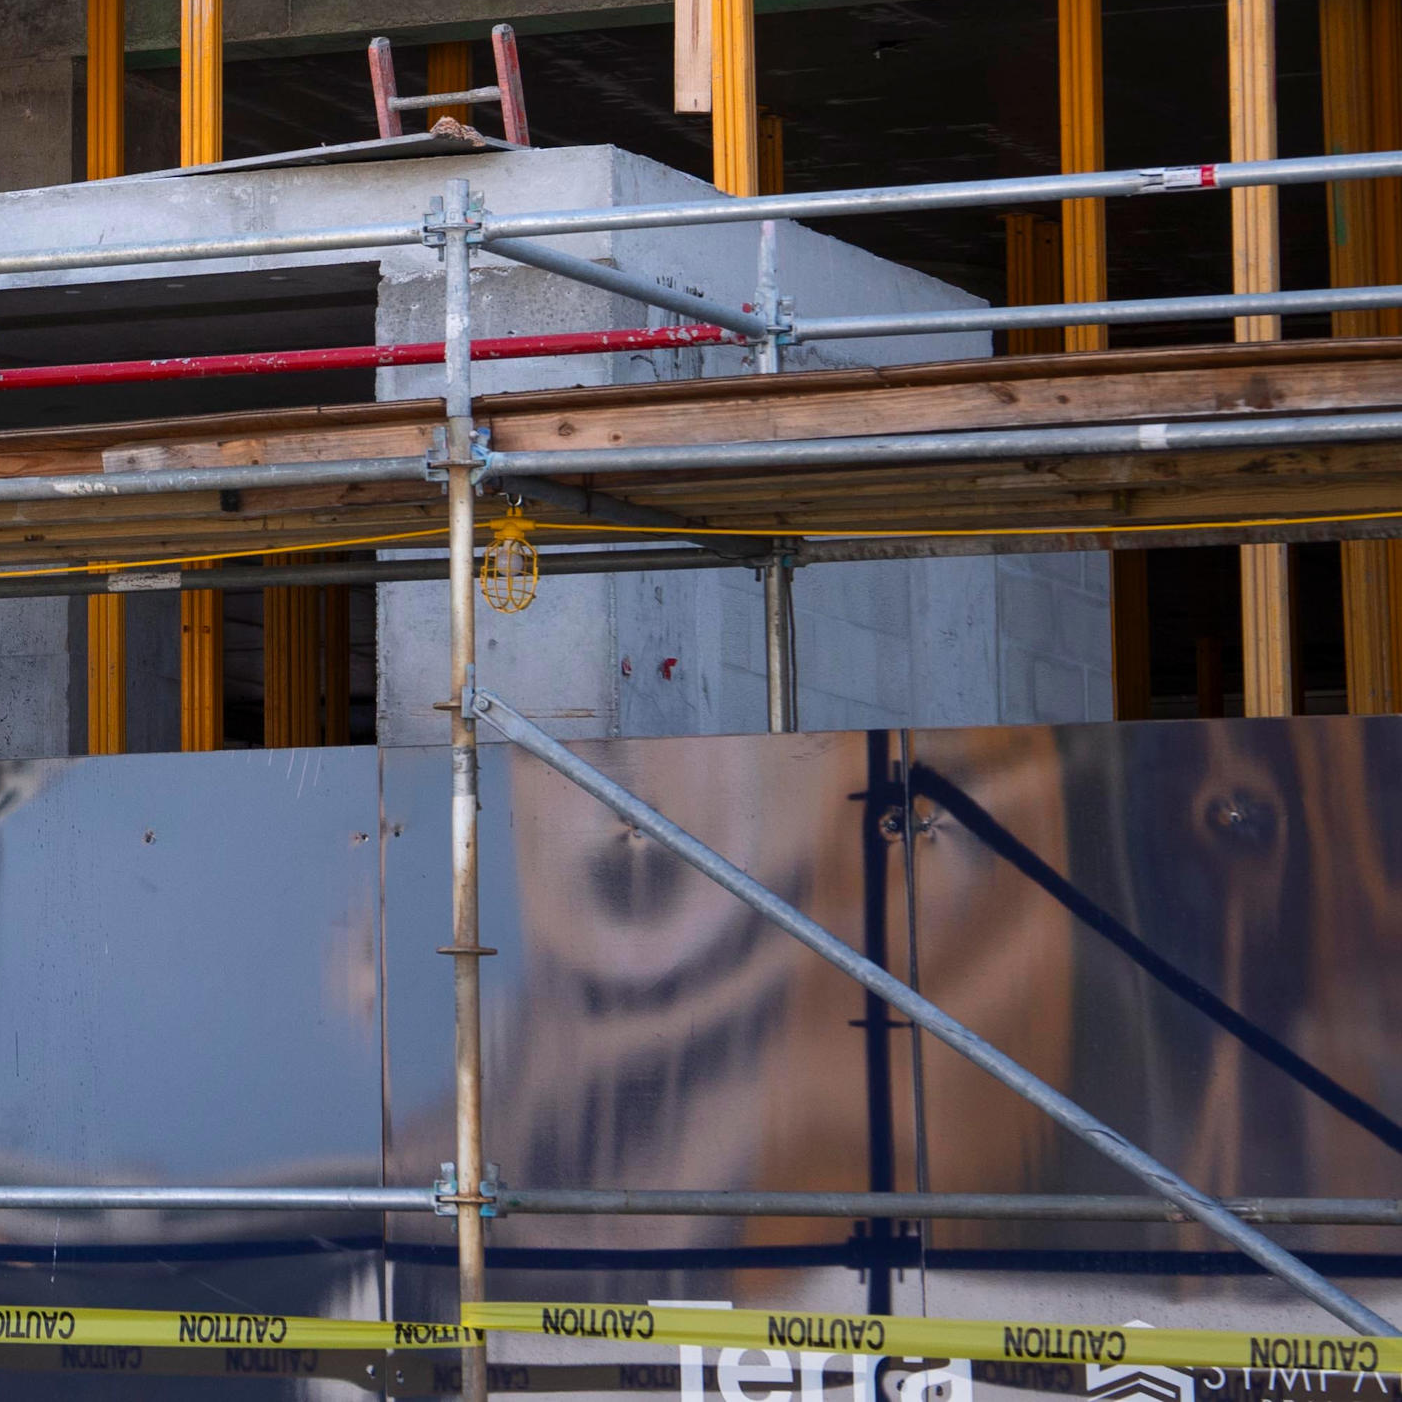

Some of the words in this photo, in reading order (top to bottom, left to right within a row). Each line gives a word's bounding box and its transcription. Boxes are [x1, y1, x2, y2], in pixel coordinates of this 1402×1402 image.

[180, 1314, 286, 1344] CAUTION
[542, 1308, 654, 1339] CAUTION
[768, 1315, 885, 1351] CAUTION
[1004, 1326, 1126, 1361] CAUTION
[1250, 1337, 1378, 1371] CAUTION
